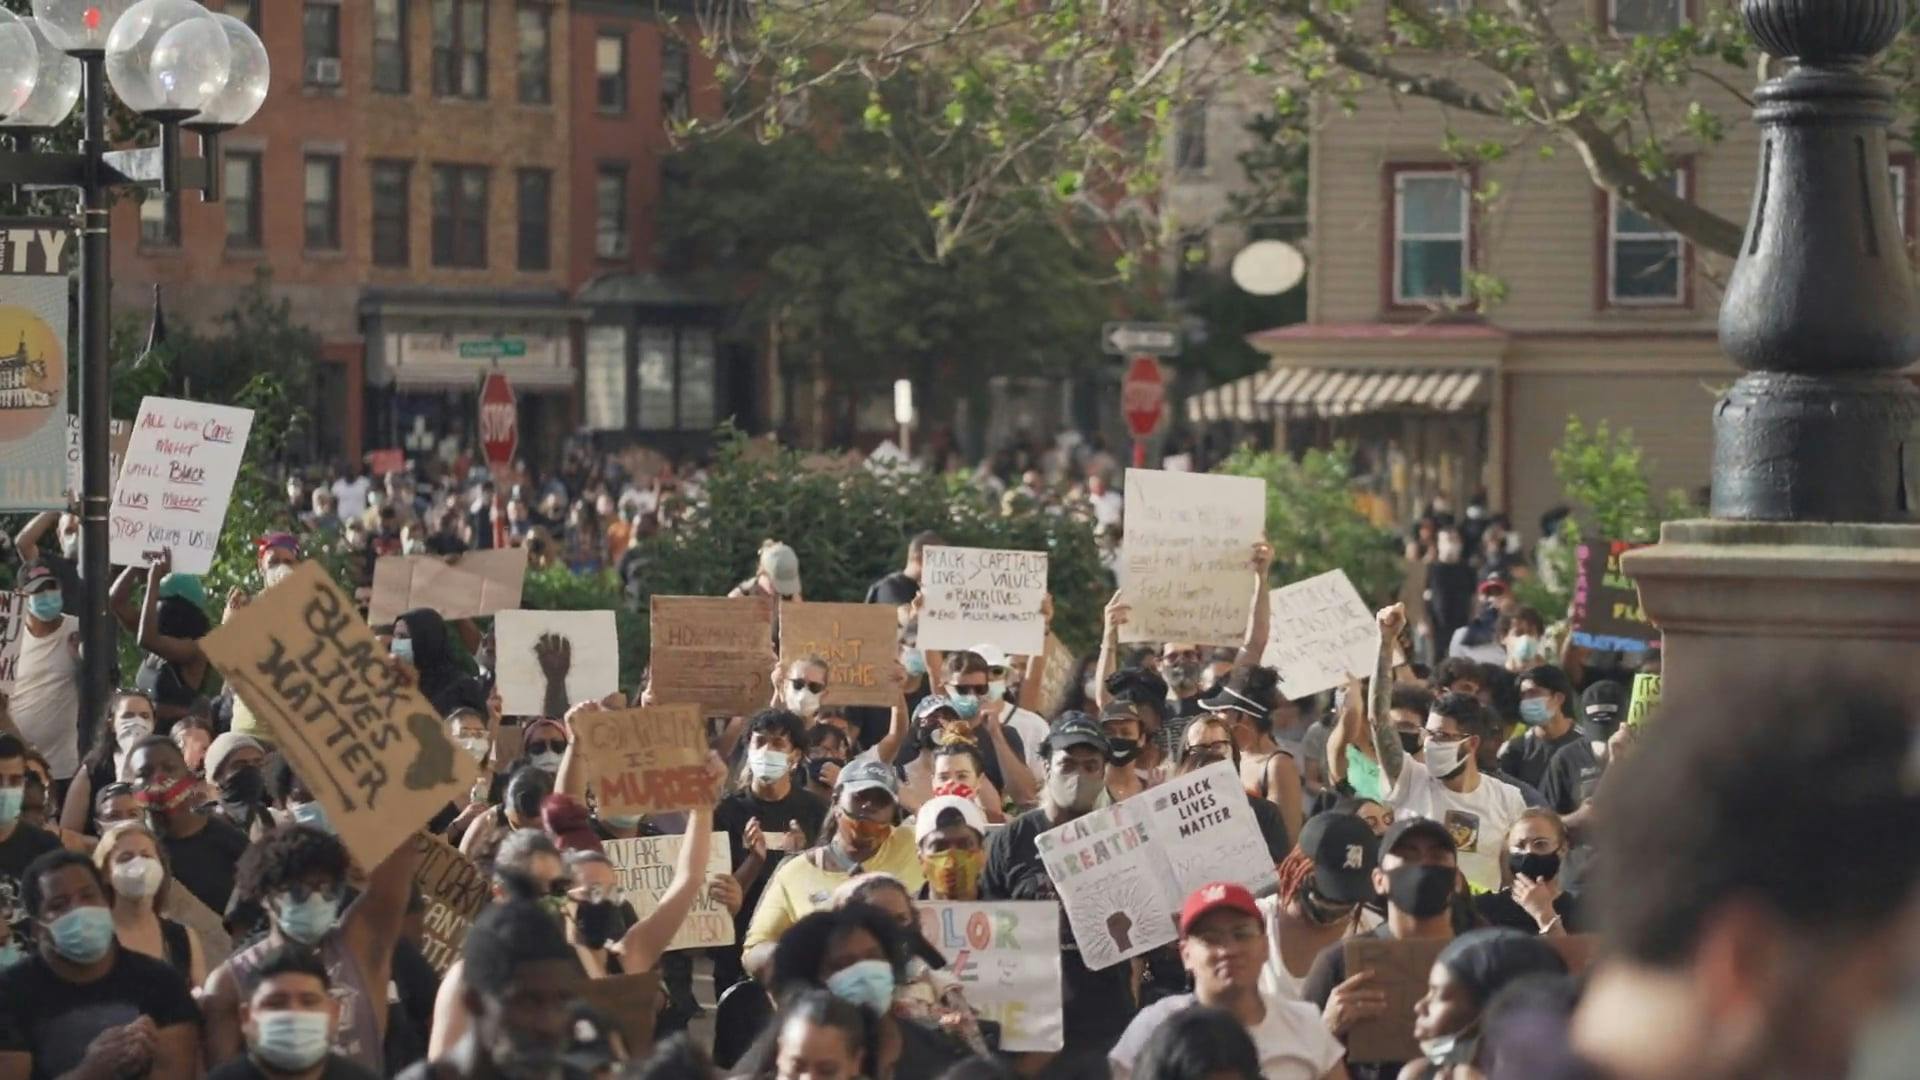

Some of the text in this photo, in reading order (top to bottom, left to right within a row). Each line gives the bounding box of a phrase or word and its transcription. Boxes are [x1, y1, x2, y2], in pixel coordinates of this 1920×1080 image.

[482, 405, 515, 443] STOP
[931, 570, 1042, 589] LIVES VALUES
[304, 582, 412, 719] BLACK
[301, 640, 402, 750] LIVES
[256, 634, 389, 811] MATTER
[600, 766, 719, 809] MURDER
[1178, 793, 1216, 820] LIVES
[1179, 807, 1232, 839] MATTER
[920, 905, 1021, 951] OLOR
